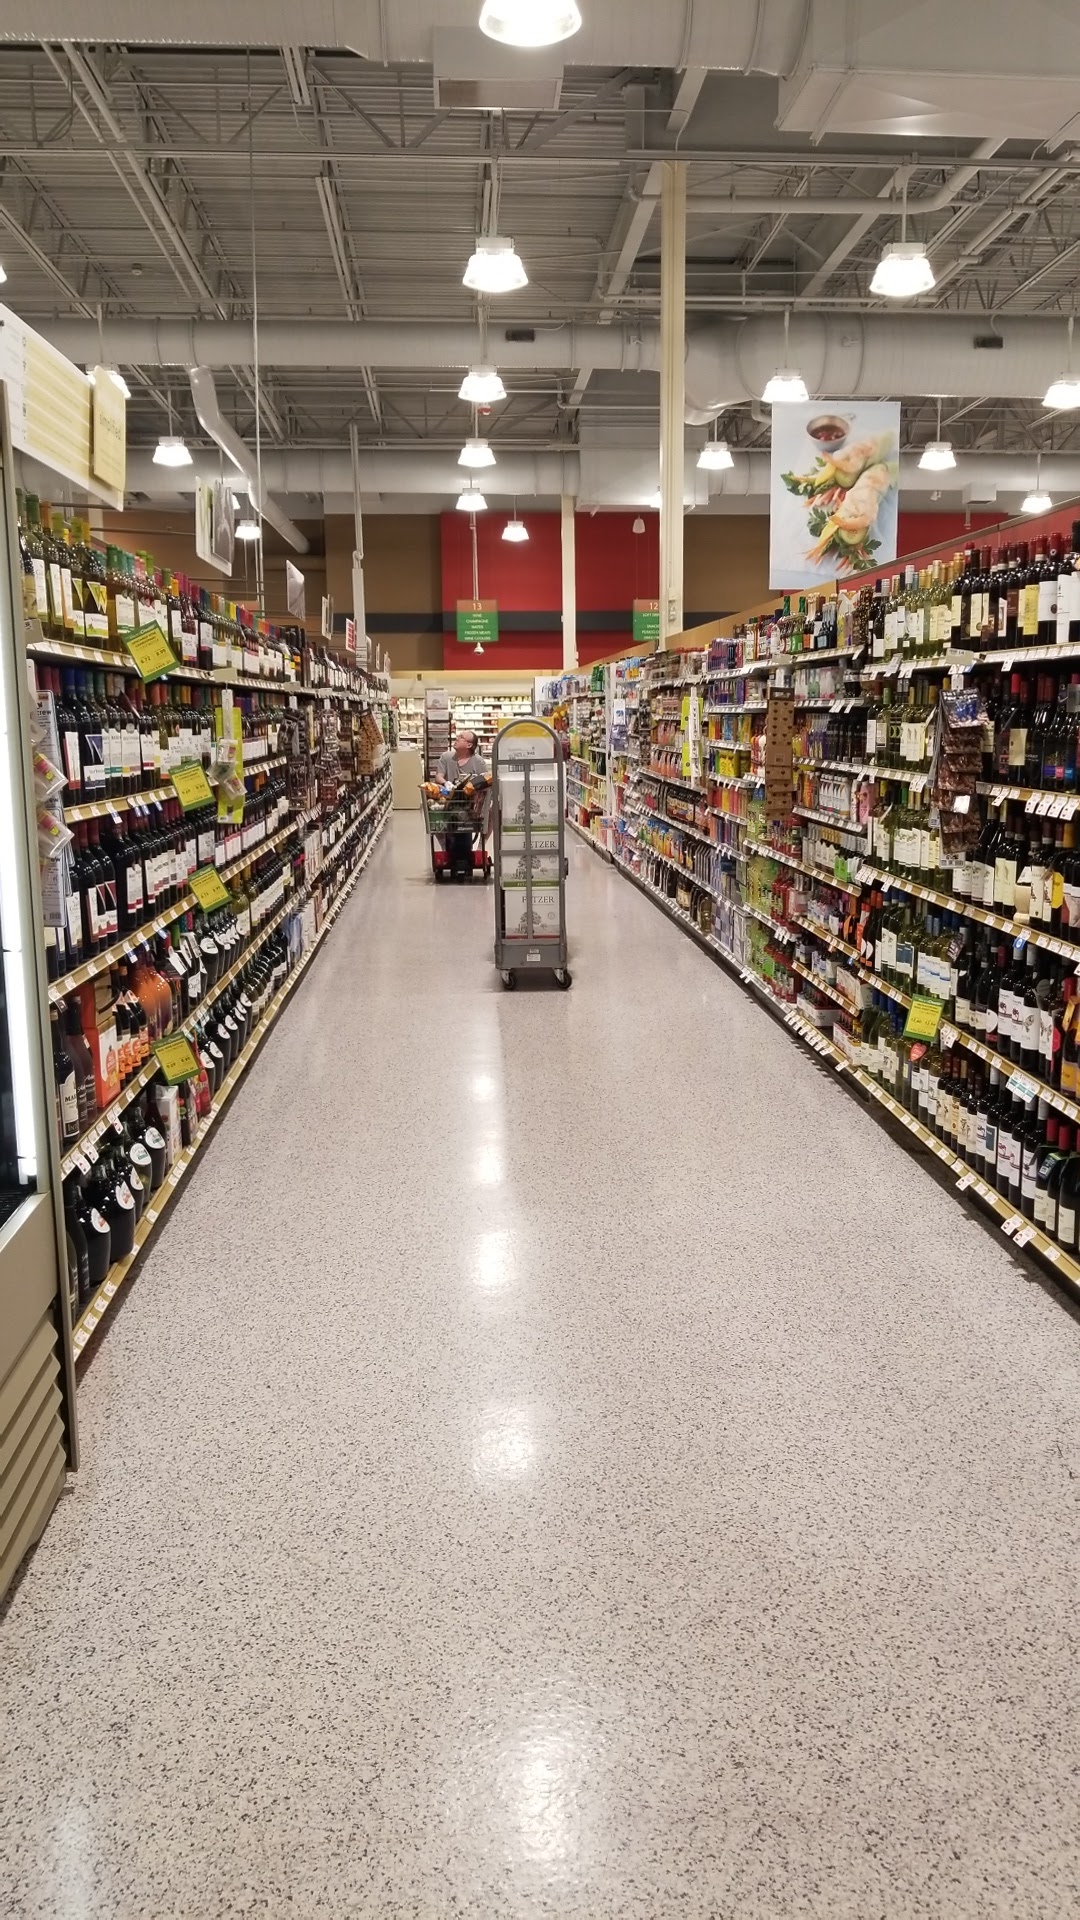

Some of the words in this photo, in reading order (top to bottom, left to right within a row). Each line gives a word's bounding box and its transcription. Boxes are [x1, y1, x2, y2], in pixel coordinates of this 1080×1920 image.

[472, 602, 482, 611] 13
[649, 602, 659, 610] 12
[522, 895, 554, 903] FTZER
